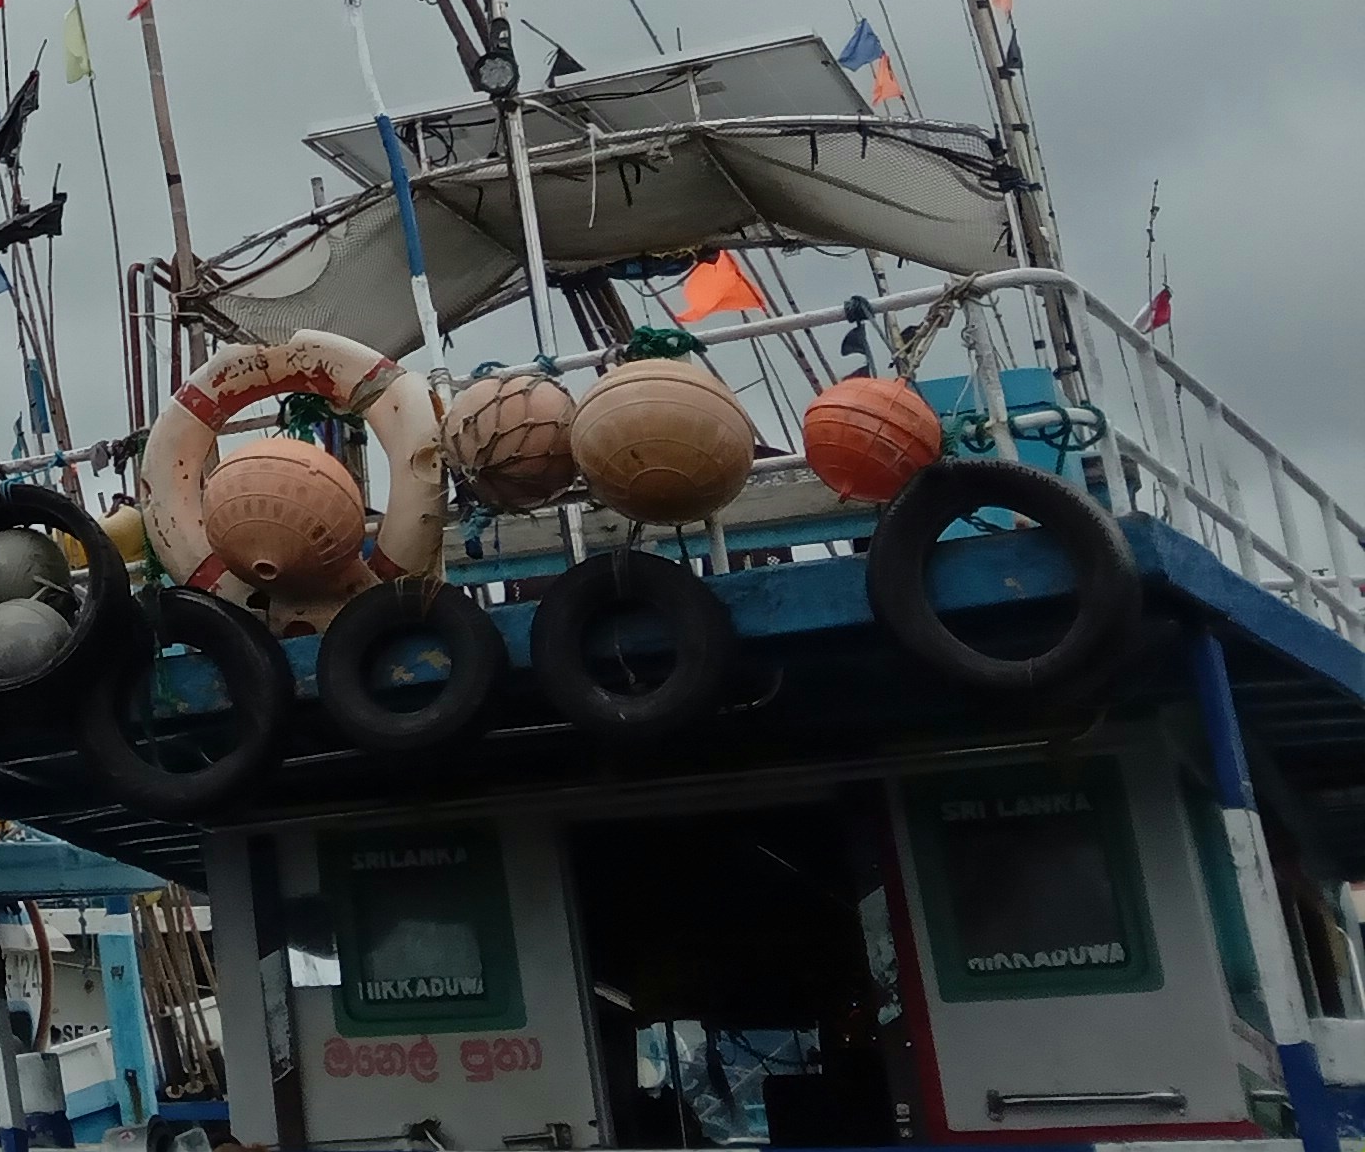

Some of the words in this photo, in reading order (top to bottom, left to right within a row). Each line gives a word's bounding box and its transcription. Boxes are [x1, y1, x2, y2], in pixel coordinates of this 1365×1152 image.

[941, 799, 986, 821] SRI
[996, 792, 1094, 818] LANKA
[460, 1037, 542, 1083] පුතා
